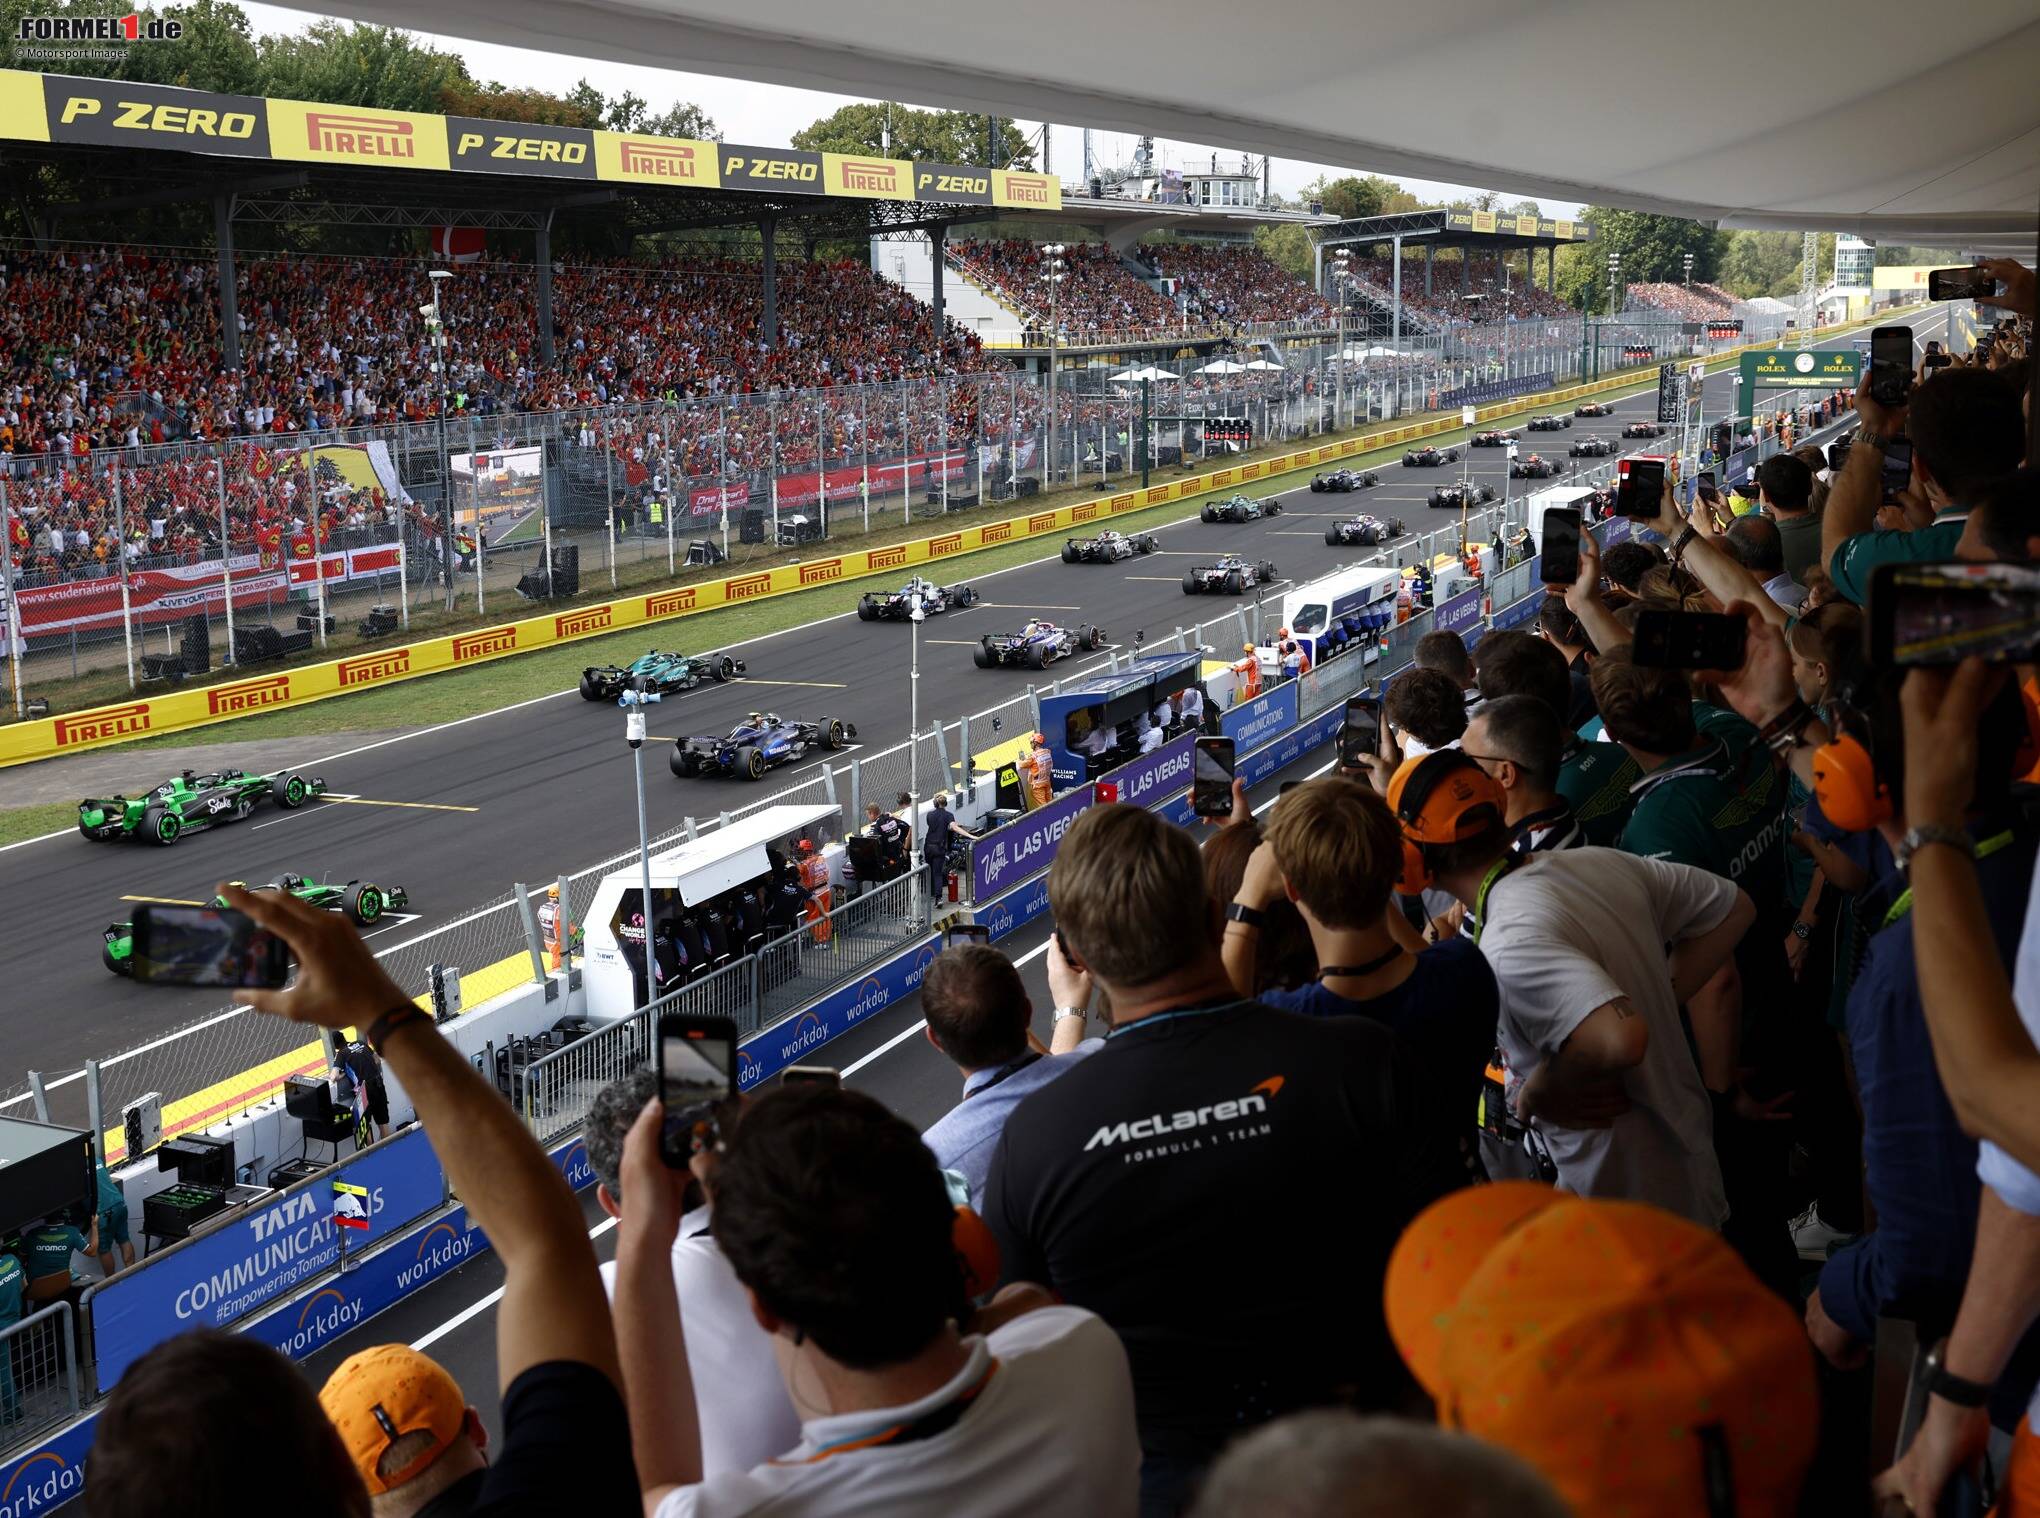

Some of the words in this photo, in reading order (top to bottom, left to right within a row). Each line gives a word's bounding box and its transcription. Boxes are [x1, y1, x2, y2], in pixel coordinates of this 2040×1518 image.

[60, 97, 101, 124] P
[112, 102, 256, 138] ZERO
[306, 112, 414, 158] PIRELLI
[457, 133, 484, 155] P
[490, 136, 587, 164] ZERO
[620, 141, 695, 178] PIRELLI
[725, 157, 745, 176] P
[750, 158, 817, 182] ZERO
[842, 161, 897, 193] PIRELLI
[918, 173, 935, 190] P
[936, 175, 988, 194] ZERO
[1006, 176, 1048, 204] PIRELLI
[1213, 470, 1232, 487] PIRELLI
[1242, 464, 1260, 480] PIRELLI
[1147, 486, 1169, 503] PIRELLI
[1181, 478, 1201, 495] PIRELLI
[692, 505, 712, 515] One
[1072, 503, 1097, 521] PIRELLI
[1111, 494, 1134, 512] PIRELLI
[982, 522, 1011, 543] PIRELLI
[1029, 513, 1056, 532] PIRELLI
[868, 546, 906, 569] PIRELLI
[929, 534, 962, 556] PIRELLI
[799, 559, 843, 584] PIRELLI
[726, 573, 772, 600] PIRELLI
[646, 589, 697, 617] PIRELLI
[555, 606, 612, 638] PIRELLI
[453, 627, 517, 662] PIRELLI
[338, 649, 411, 686] PIRELLI
[208, 676, 291, 715] PIRELLI
[1253, 699, 1268, 714] TATA
[55, 703, 151, 746] PIRELLI
[1237, 707, 1284, 742] COMMUNICATIONS
[1281, 743, 1299, 761] workday
[1131, 776, 1152, 797] LAS
[1155, 751, 1190, 784] VEGAS
[1255, 758, 1275, 776] workday
[208, 797, 232, 814] Stake
[1014, 831, 1042, 862] LAS
[846, 987, 890, 1022] workday
[782, 1023, 830, 1059] workday
[1084, 1094, 1266, 1152] McLaren
[1125, 1139, 1202, 1163] FORMULA
[1228, 1124, 1272, 1142] TEAM
[250, 1191, 316, 1243] TATA
[36, 1243, 67, 1252] aramco
[396, 1233, 474, 1290] workday
